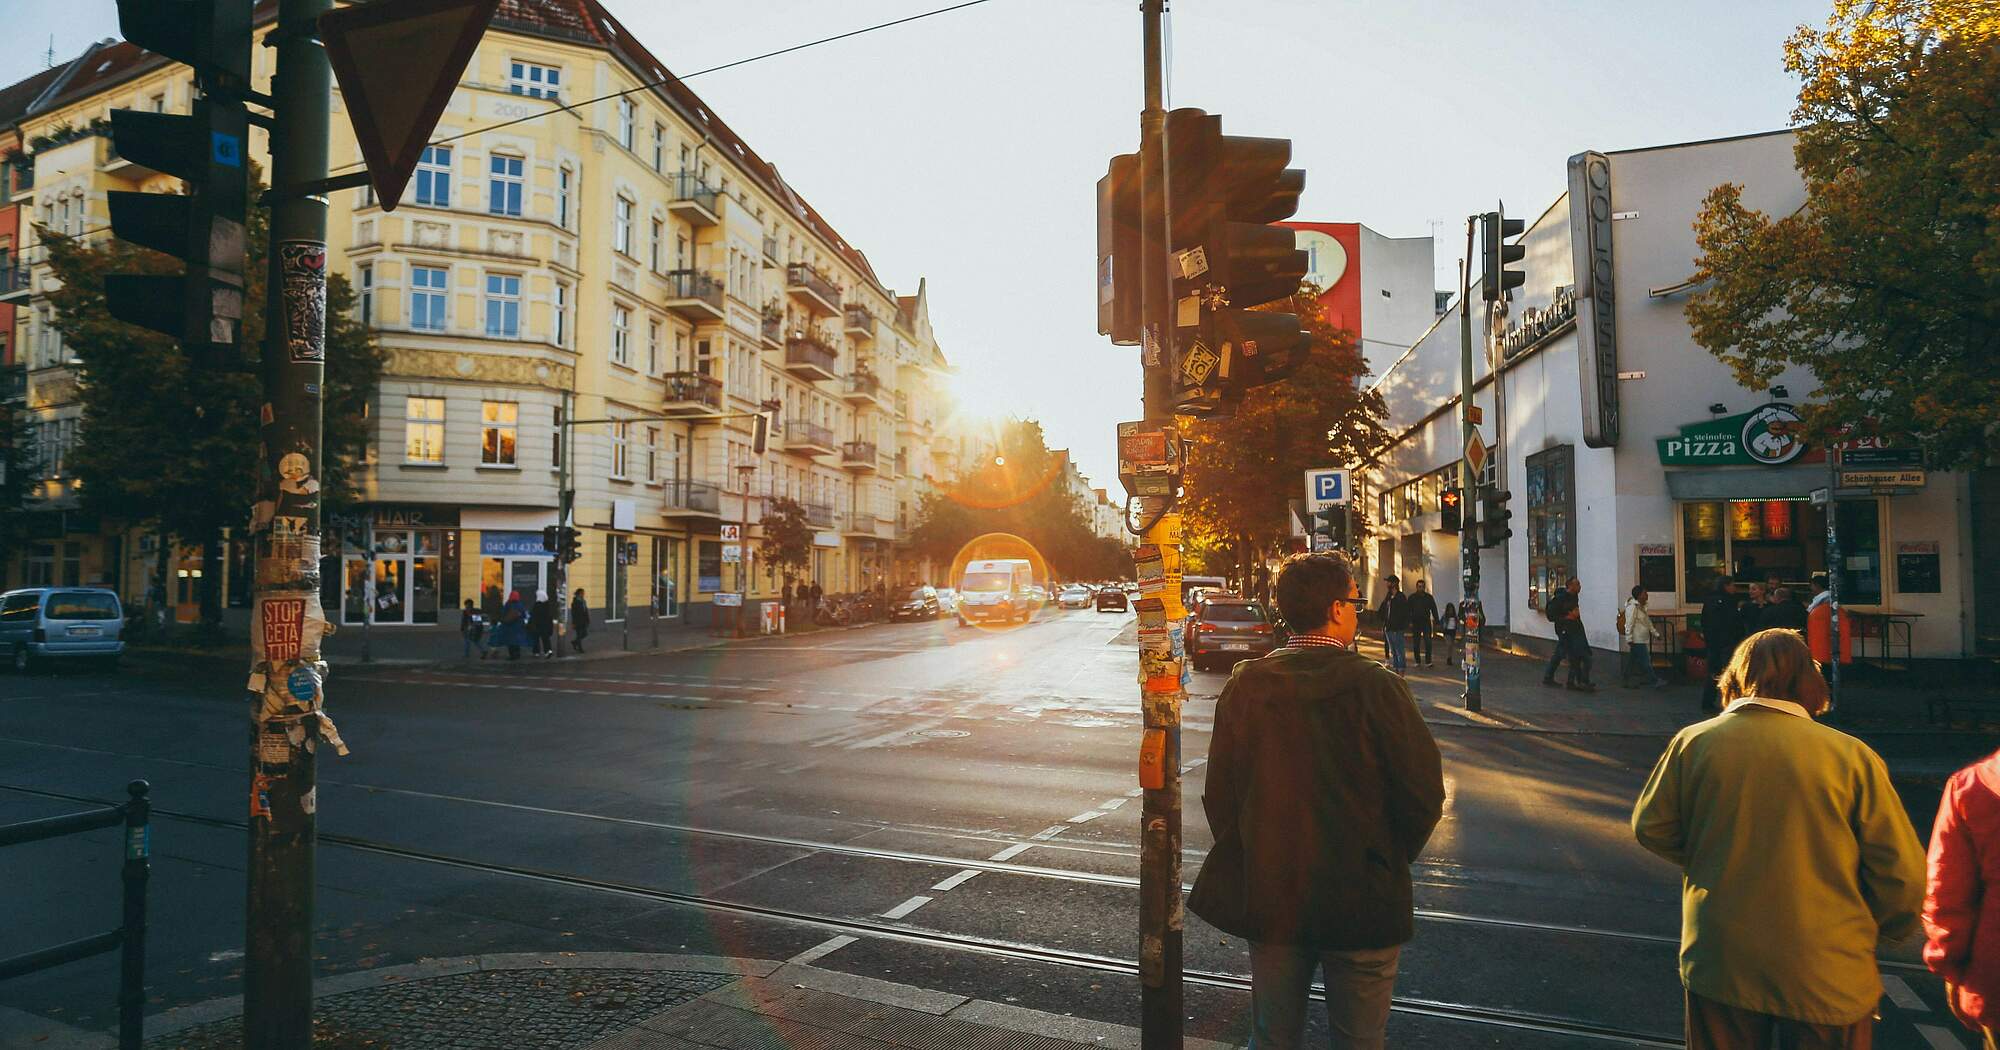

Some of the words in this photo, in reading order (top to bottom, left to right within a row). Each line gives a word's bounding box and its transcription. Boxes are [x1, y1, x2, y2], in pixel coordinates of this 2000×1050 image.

[1667, 437, 1736, 457] Pizza
[1899, 473, 1921, 482] Allee
[264, 600, 302, 623] STOP
[265, 623, 299, 643] CETA
[267, 642, 299, 661] TTIP
